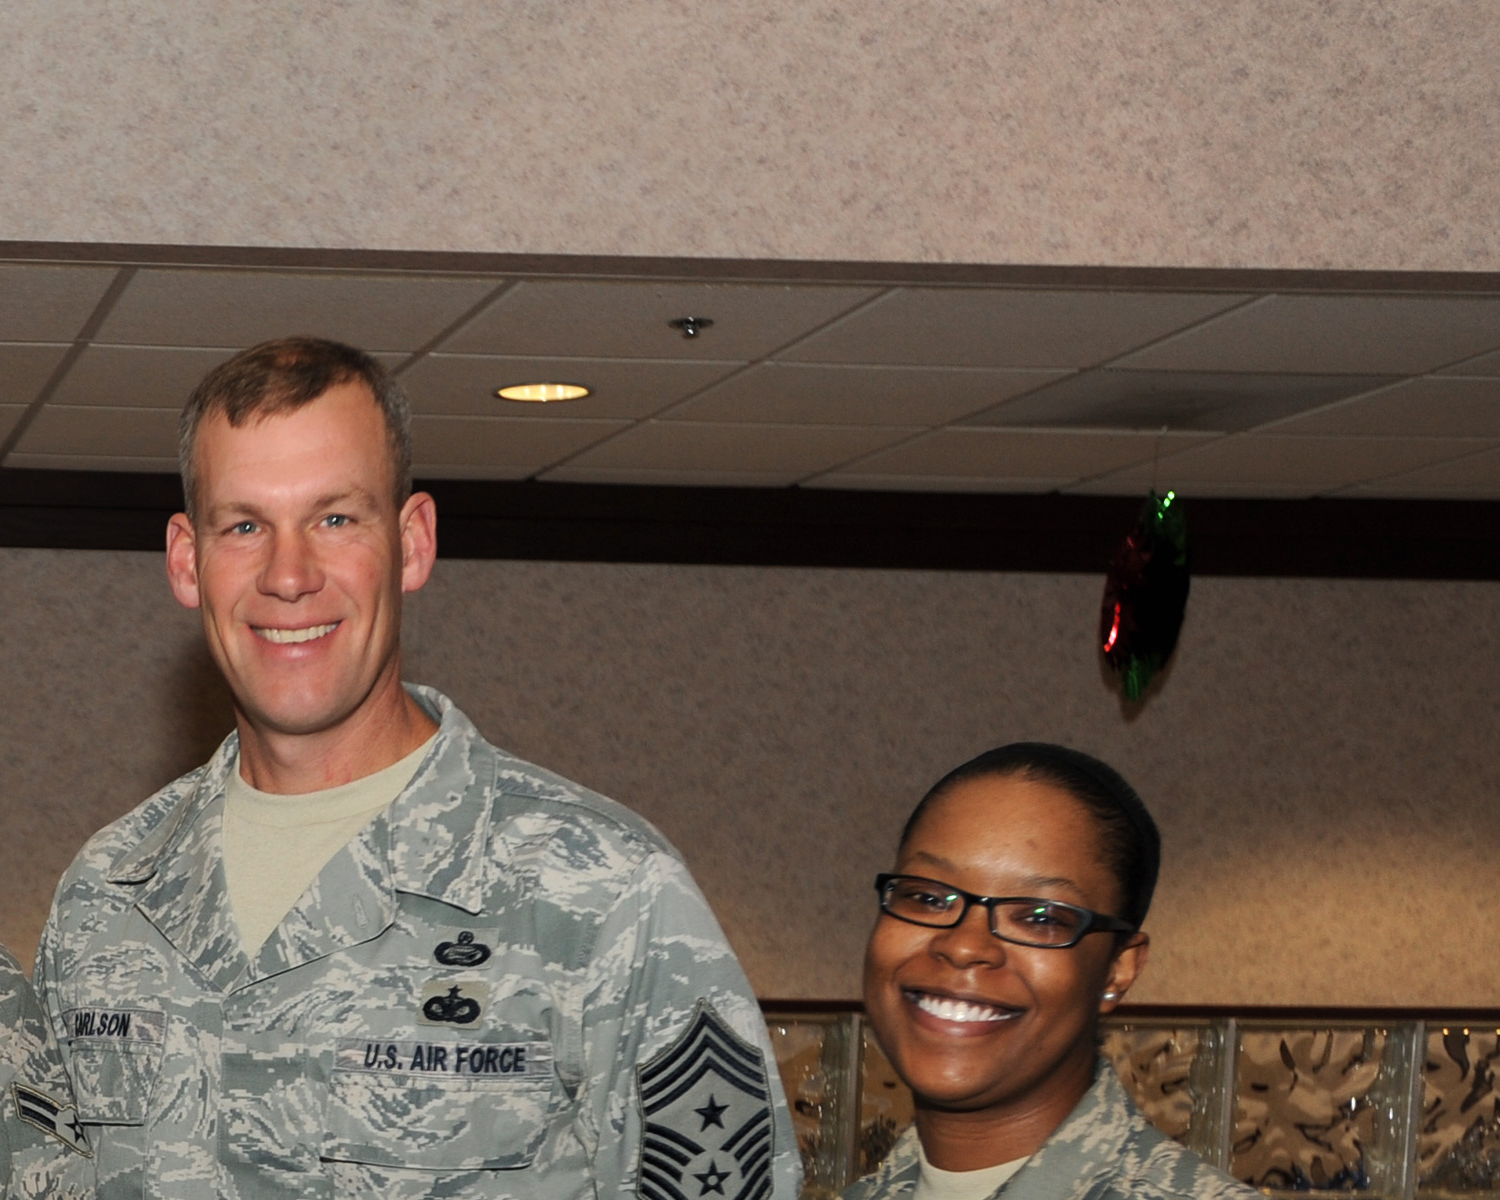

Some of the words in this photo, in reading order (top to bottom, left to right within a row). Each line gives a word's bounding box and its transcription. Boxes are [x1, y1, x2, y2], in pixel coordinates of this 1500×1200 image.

[364, 1043, 402, 1070] U.S.
[410, 1044, 448, 1072] AIR
[455, 1046, 526, 1073] FORCE
